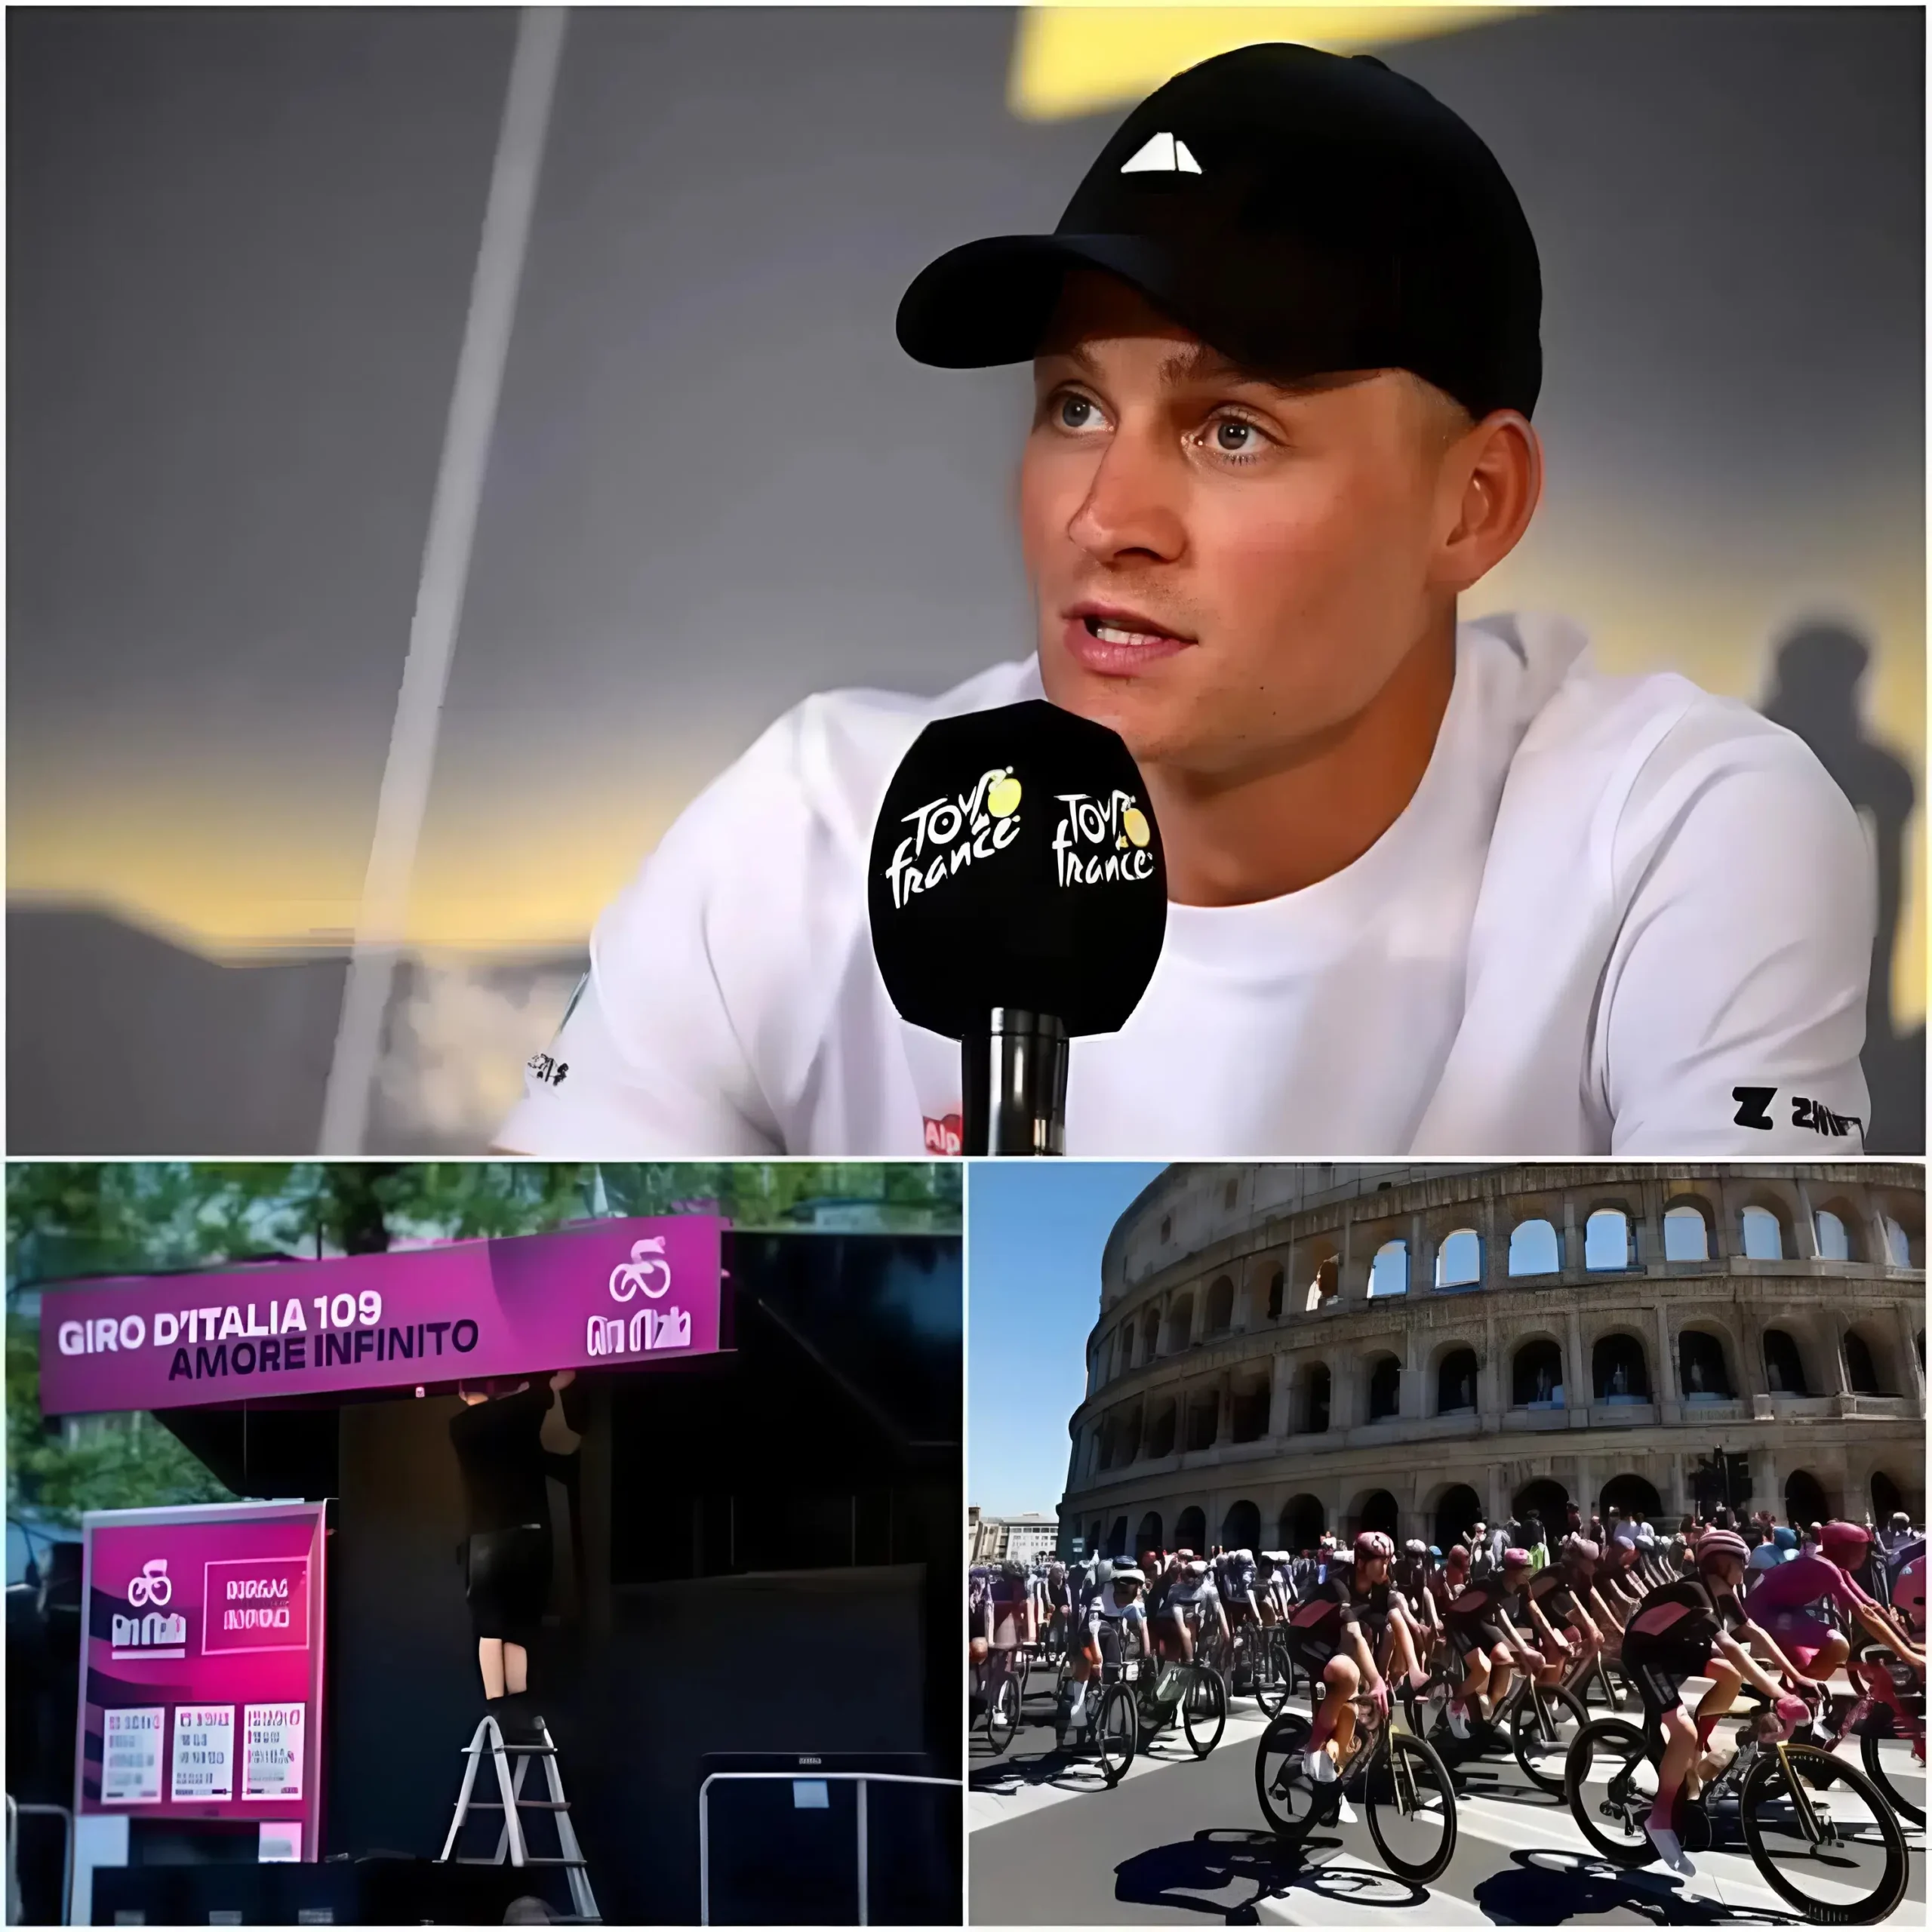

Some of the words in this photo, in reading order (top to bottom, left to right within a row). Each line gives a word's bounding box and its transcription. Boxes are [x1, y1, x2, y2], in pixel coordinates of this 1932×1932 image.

[58, 1315, 146, 1355] GIRO
[153, 1298, 307, 1346] D'ITALIA
[314, 1290, 382, 1329] 109
[168, 1337, 306, 1381] AMORE
[314, 1319, 478, 1367] INFINITO
